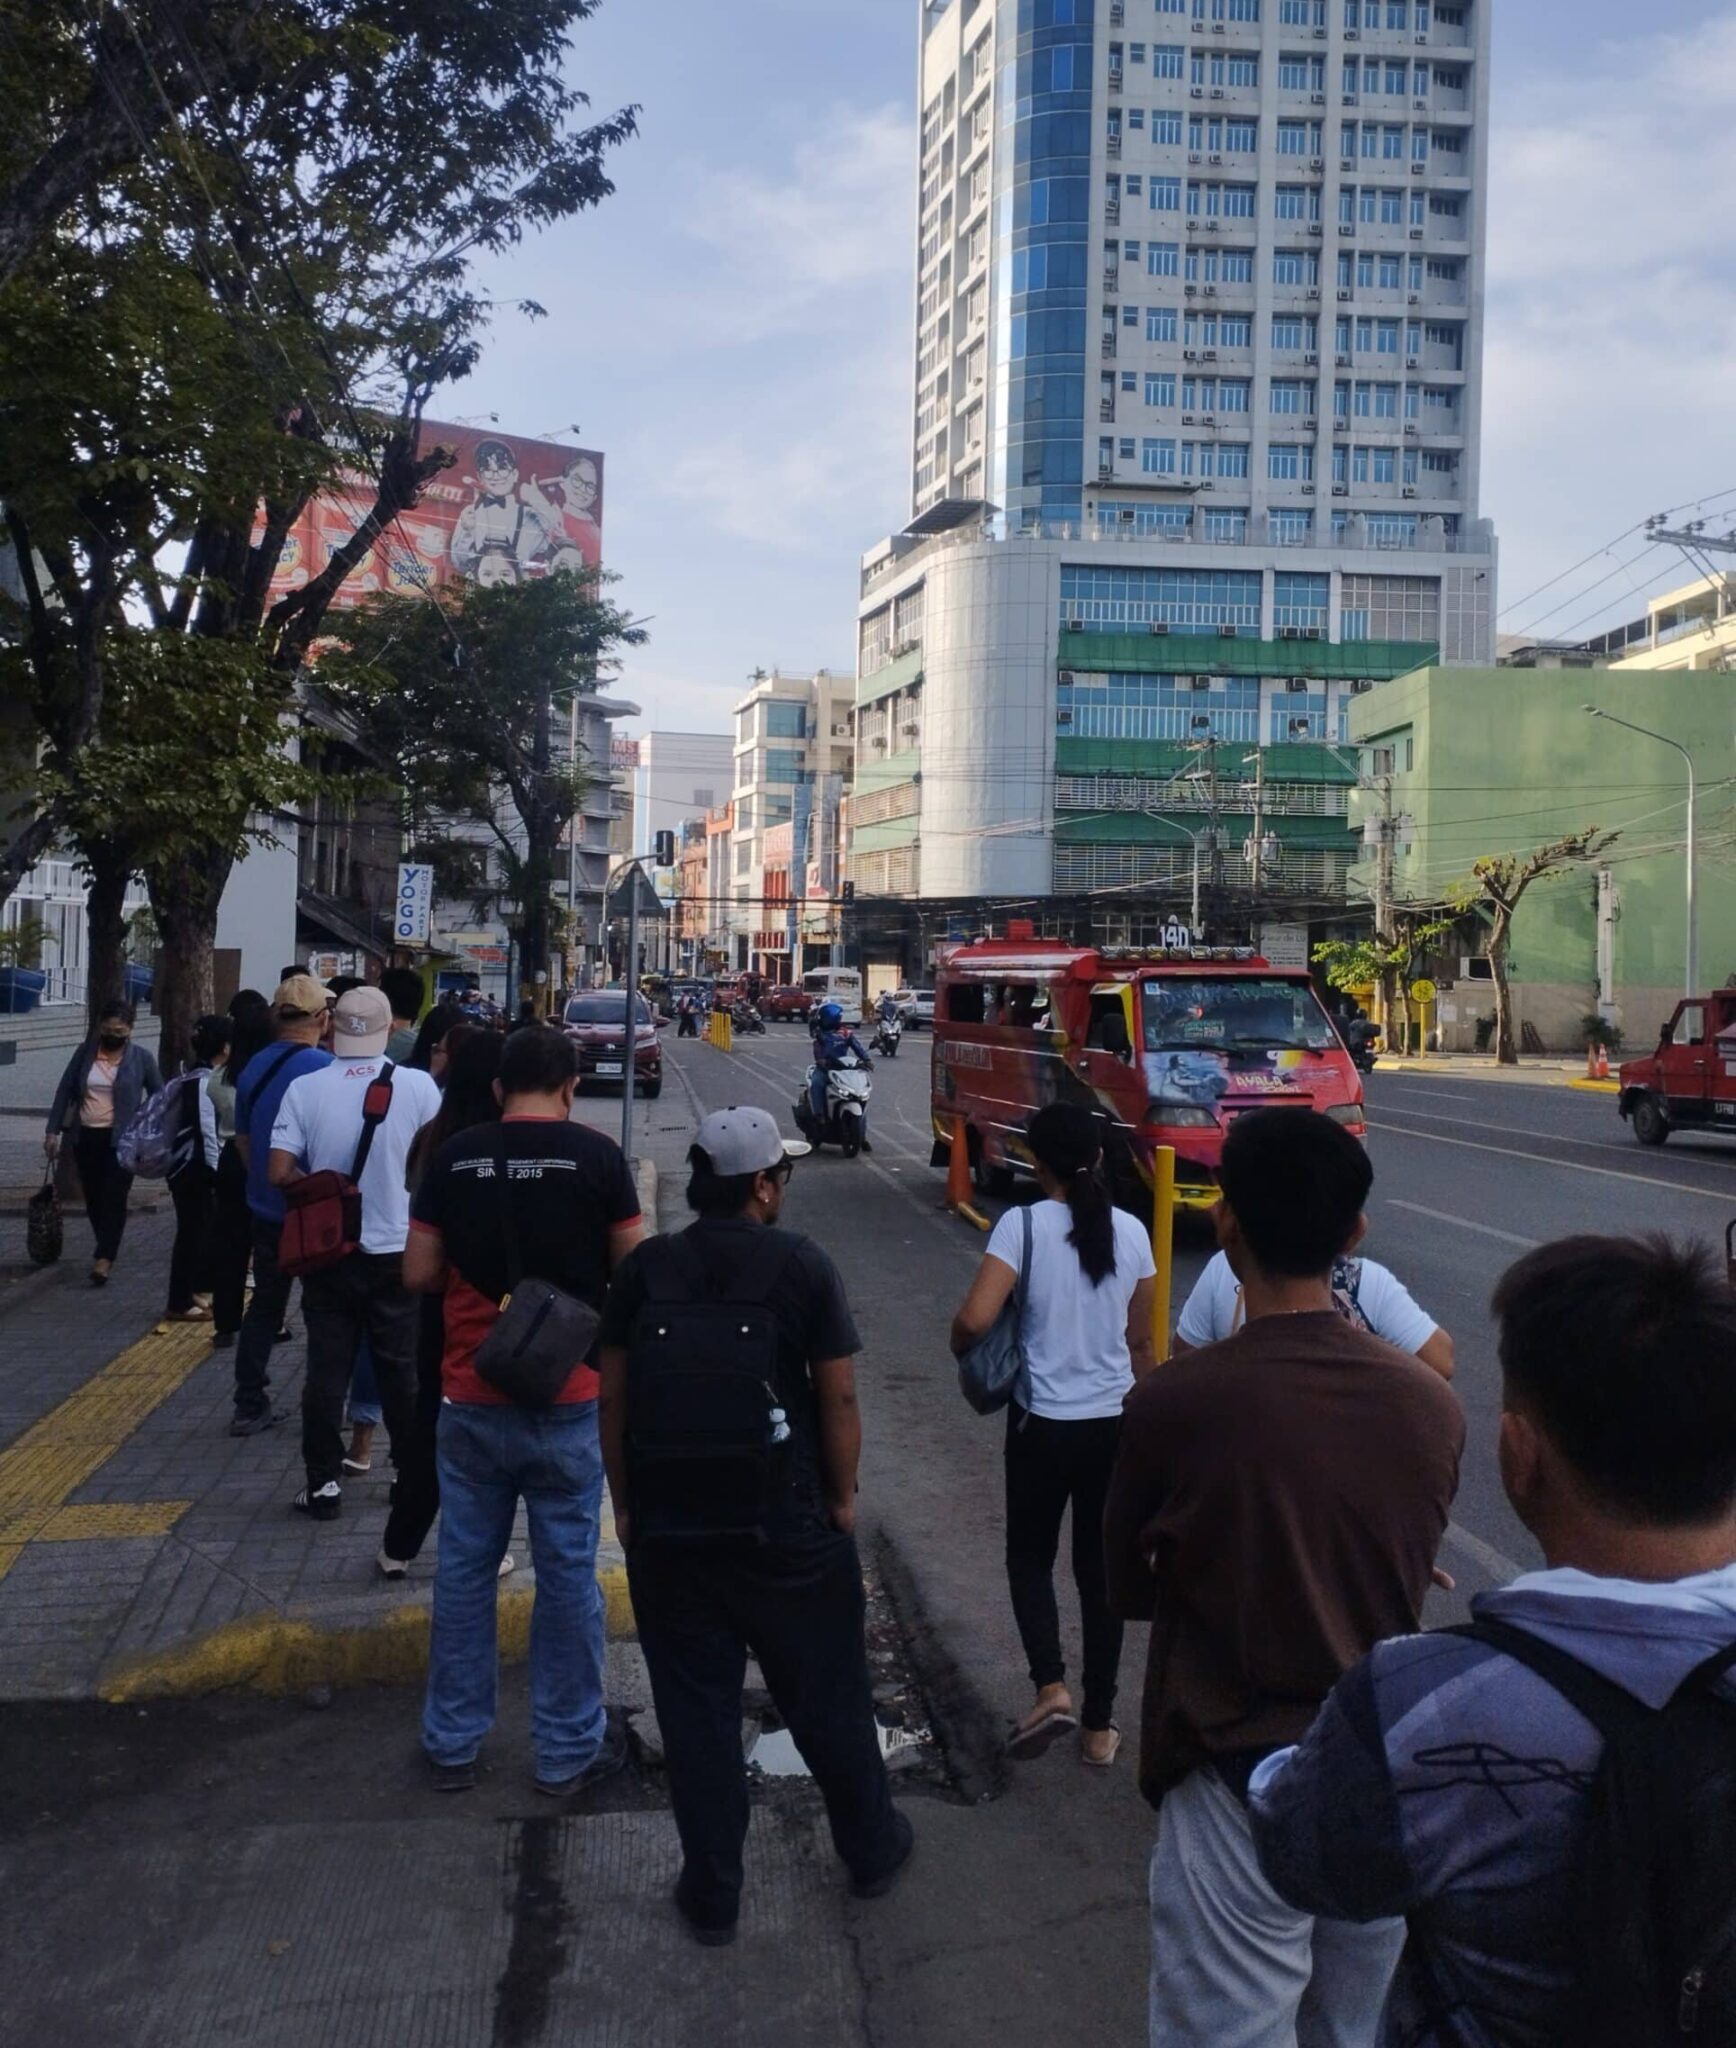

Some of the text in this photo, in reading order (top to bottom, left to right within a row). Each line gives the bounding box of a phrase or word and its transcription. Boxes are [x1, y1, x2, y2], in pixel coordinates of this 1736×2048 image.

[398, 868, 420, 937] YOGO
[344, 1066, 376, 1077] ACS
[1235, 1075, 1284, 1087] AYALA
[477, 1168, 543, 1179] SINE 2015
